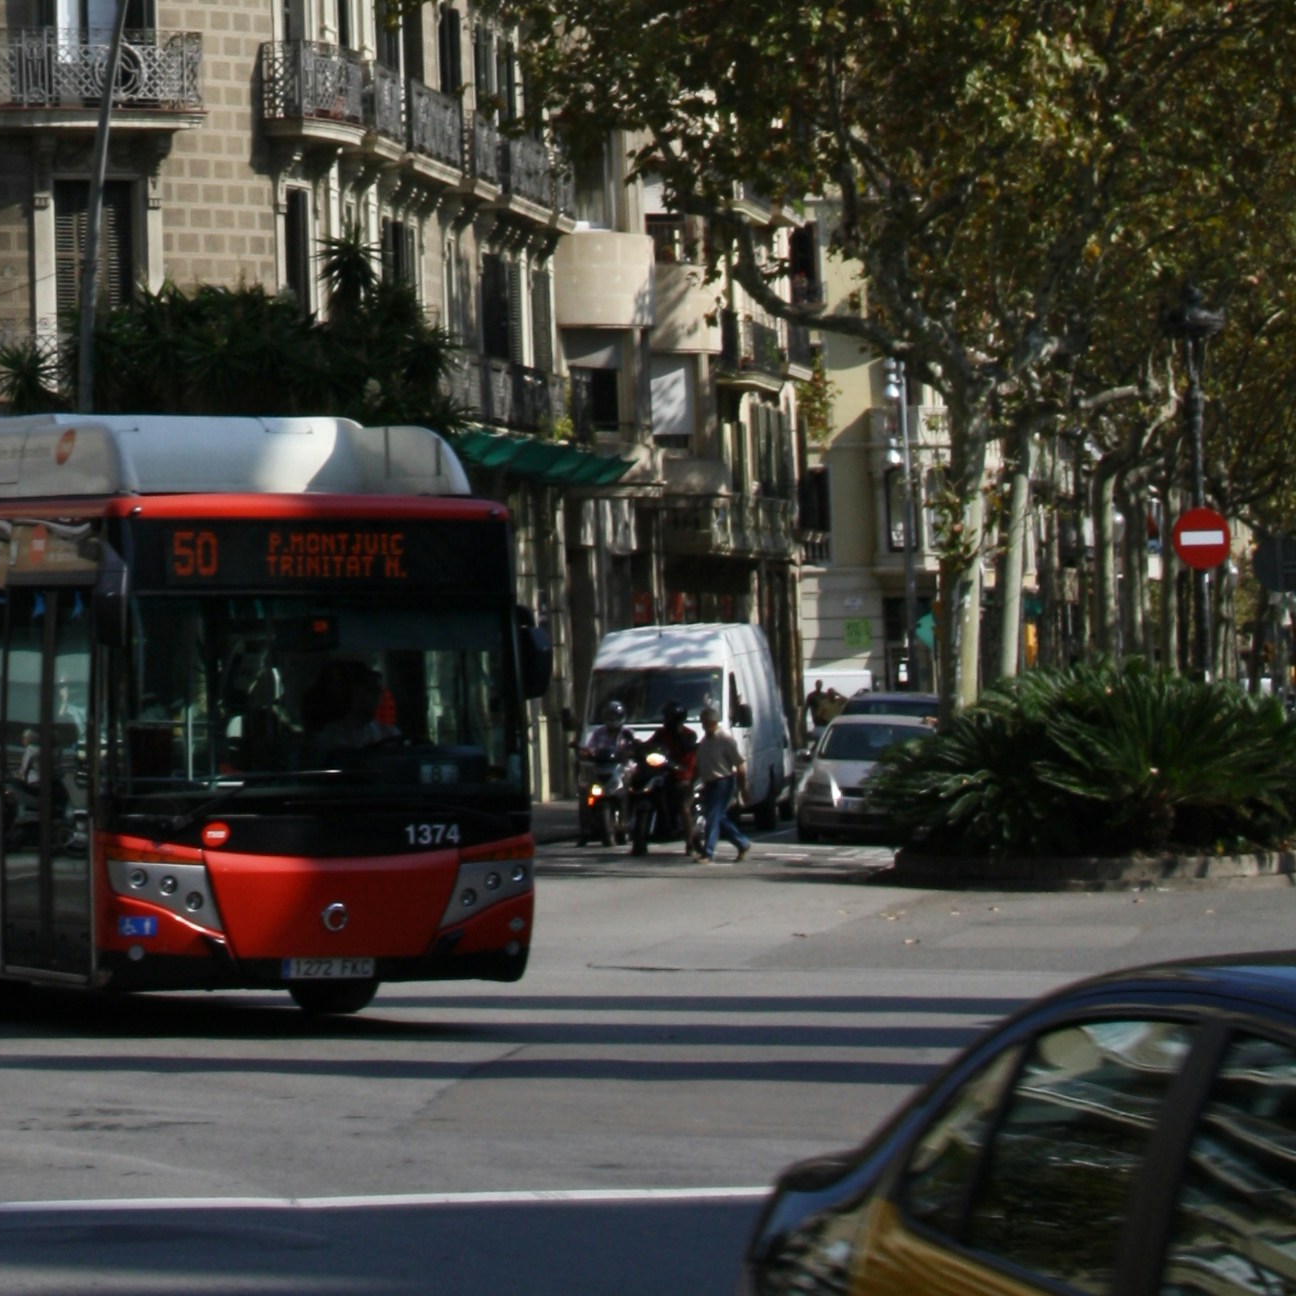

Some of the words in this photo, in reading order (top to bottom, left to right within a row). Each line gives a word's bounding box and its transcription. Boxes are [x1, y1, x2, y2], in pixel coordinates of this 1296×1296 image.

[173, 531, 218, 576] 50
[268, 532, 406, 555] P.MONTJUIC
[267, 555, 374, 577] TRINITAT
[405, 823, 461, 845] 1374
[295, 959, 333, 976] 1272
[340, 958, 371, 976] FKC
